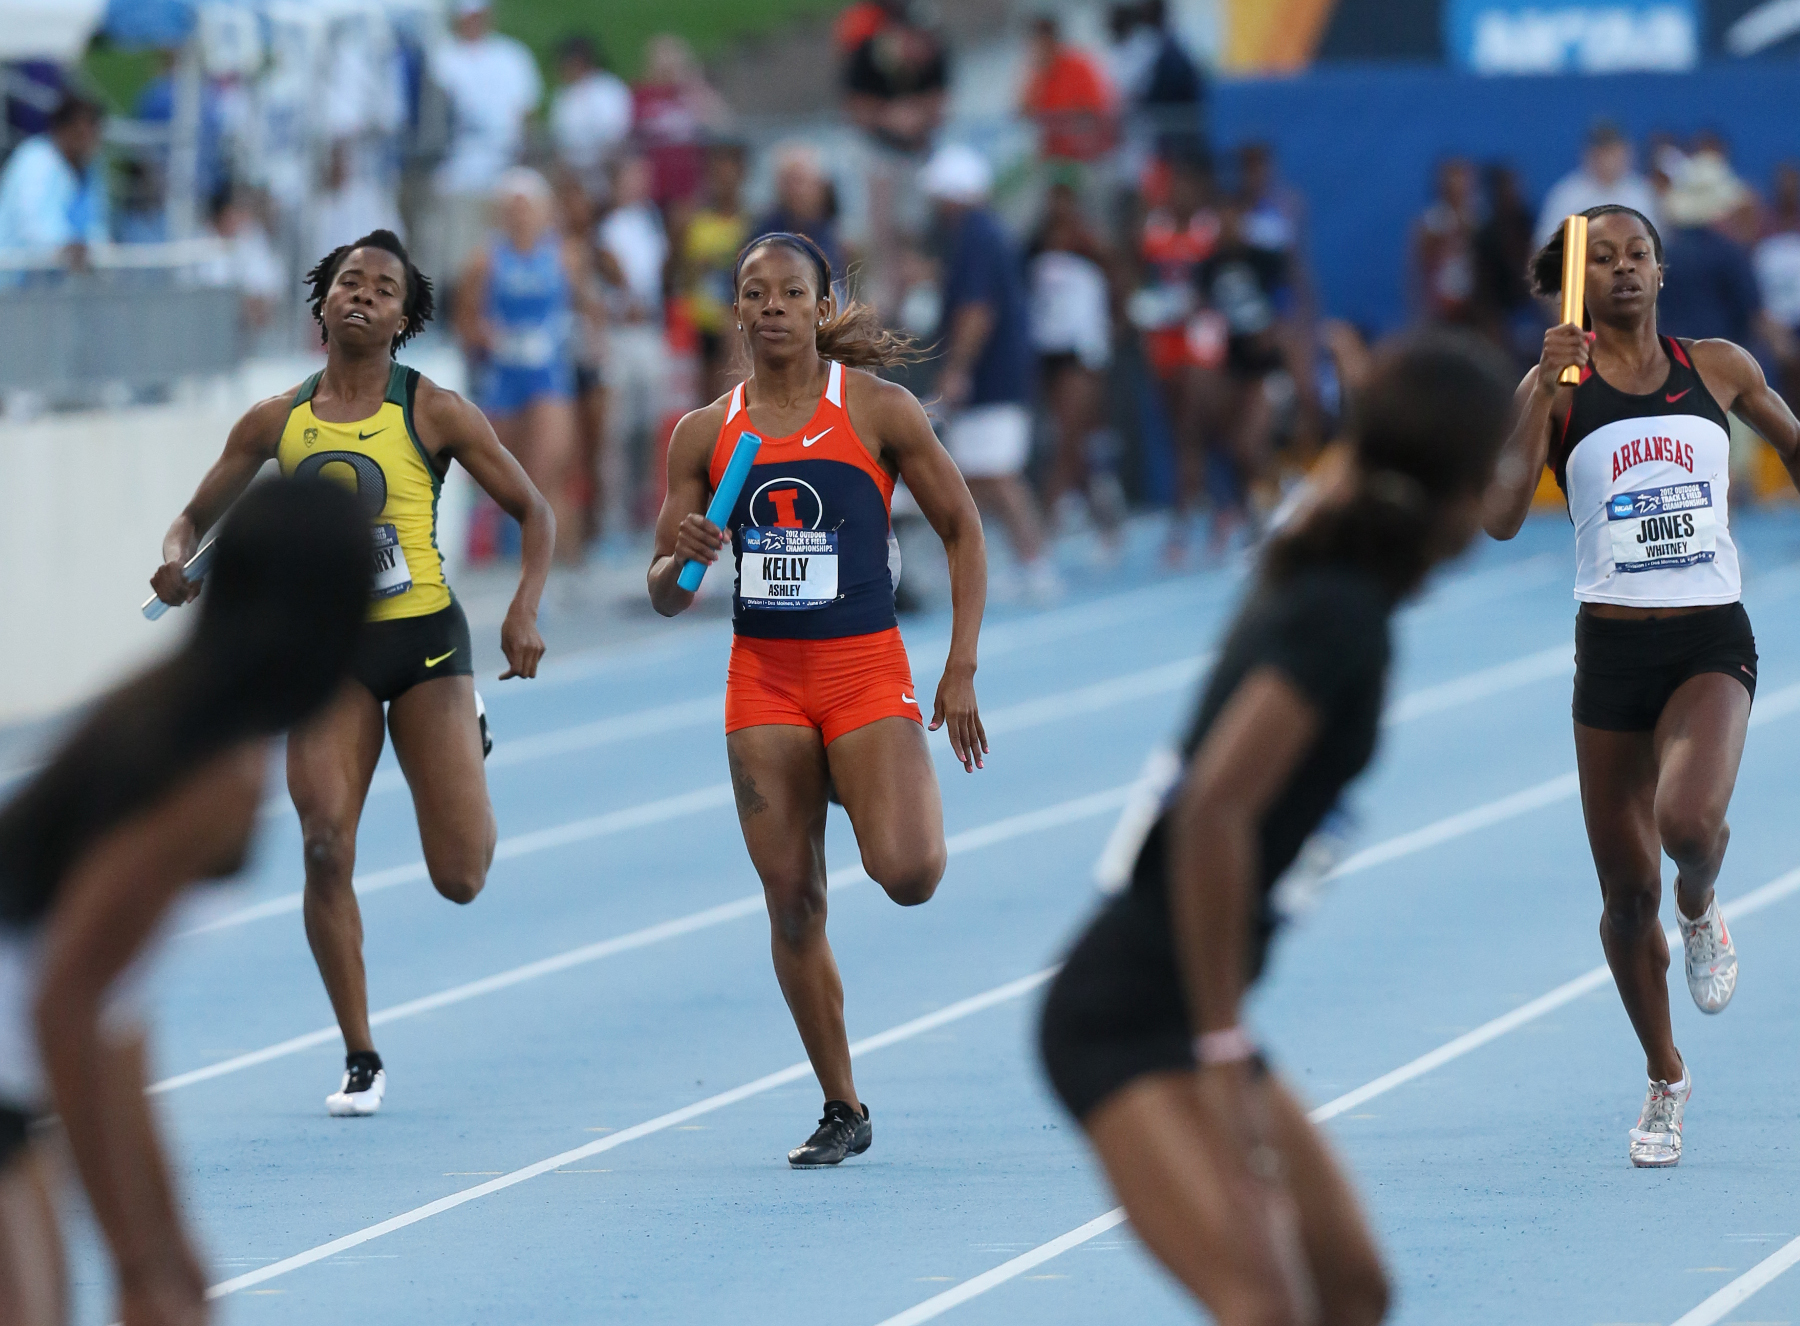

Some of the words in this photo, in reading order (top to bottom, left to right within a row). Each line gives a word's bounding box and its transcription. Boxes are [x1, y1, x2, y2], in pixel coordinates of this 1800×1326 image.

[1612, 436, 1694, 483] ARKANSAS
[1660, 487, 1673, 496] 2012
[1675, 485, 1699, 493] OUTDOOR
[1661, 495, 1680, 503] TRACK
[1662, 498, 1708, 510] CHAMPIONSHIPS
[768, 488, 803, 529] I
[1614, 504, 1633, 512] NCAA
[786, 530, 799, 538] 2012
[1636, 513, 1694, 543] JONES
[1645, 541, 1688, 558] WHITNEY
[762, 557, 809, 581] KELLY
[768, 584, 801, 597] ASHLEY
